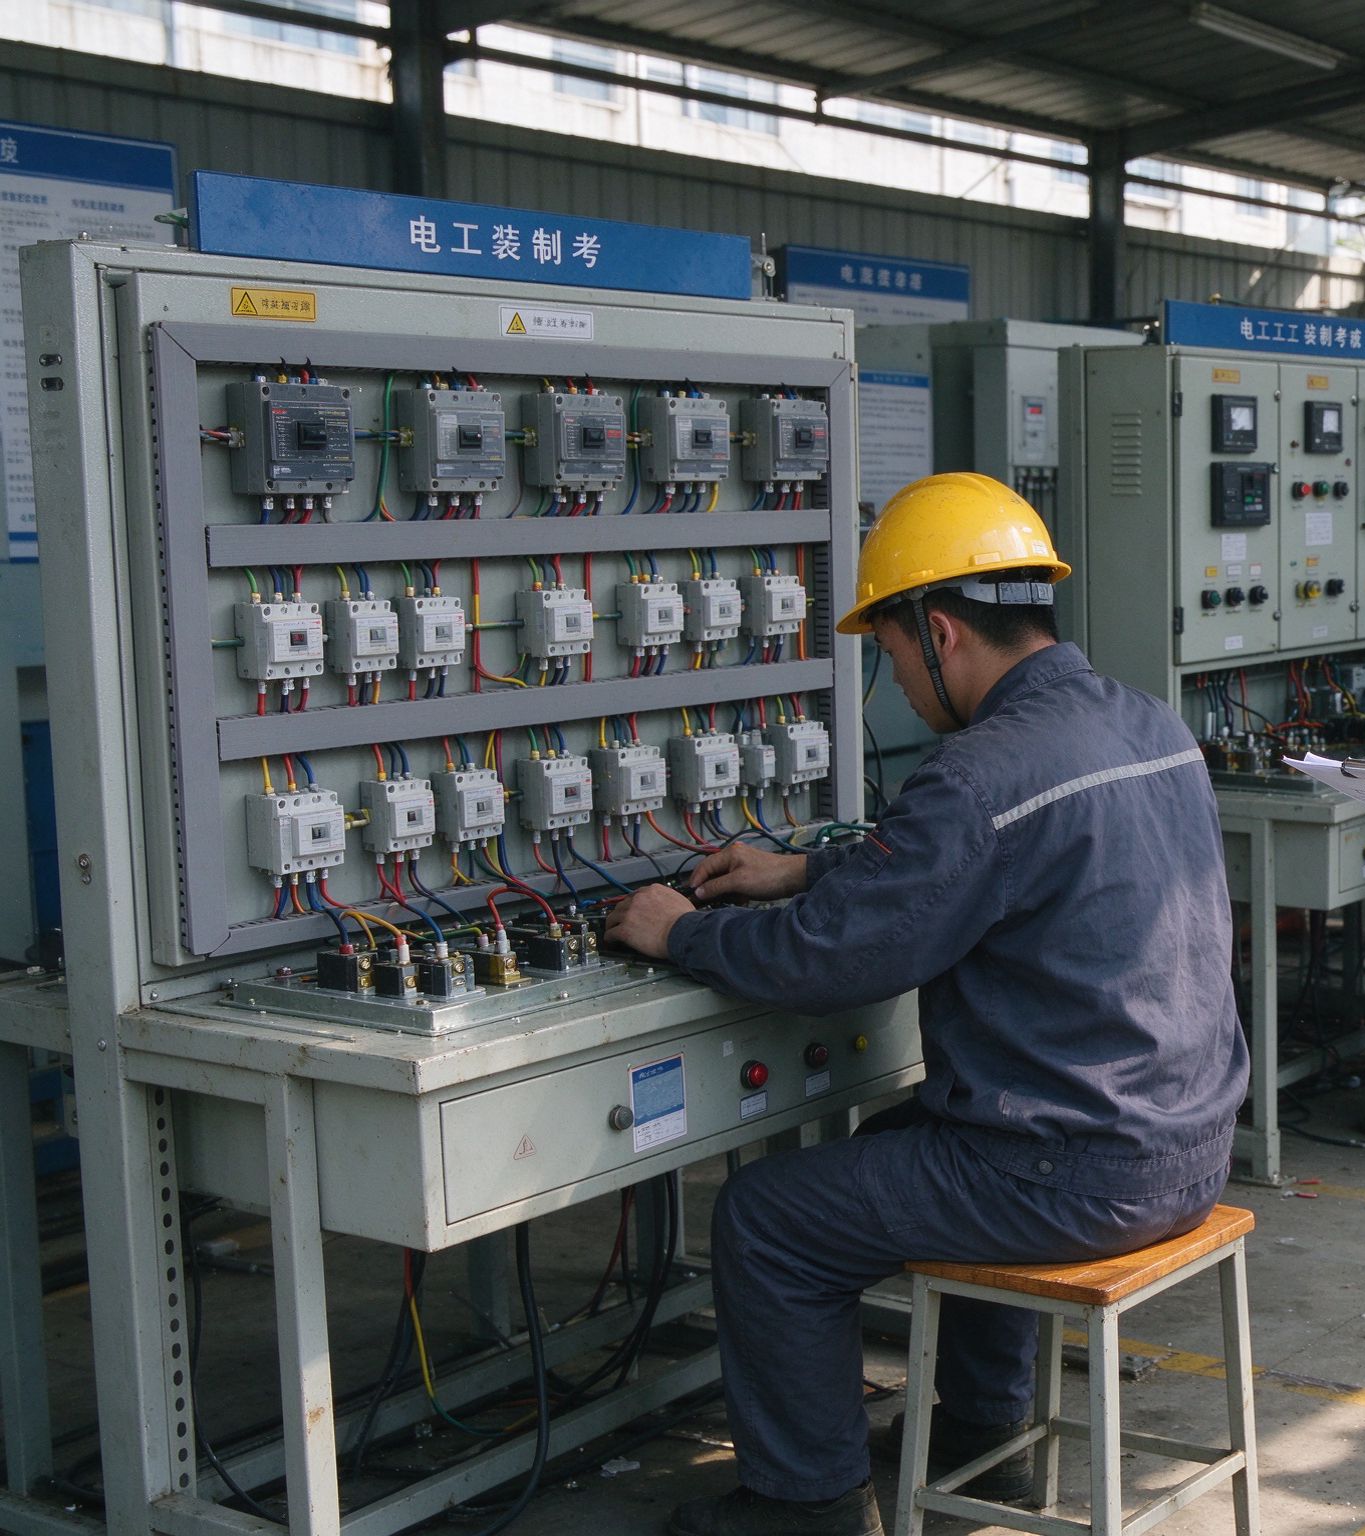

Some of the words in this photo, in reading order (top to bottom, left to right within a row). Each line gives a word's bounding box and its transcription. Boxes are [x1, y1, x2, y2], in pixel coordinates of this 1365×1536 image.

[409, 215, 601, 268] 电工装制考
